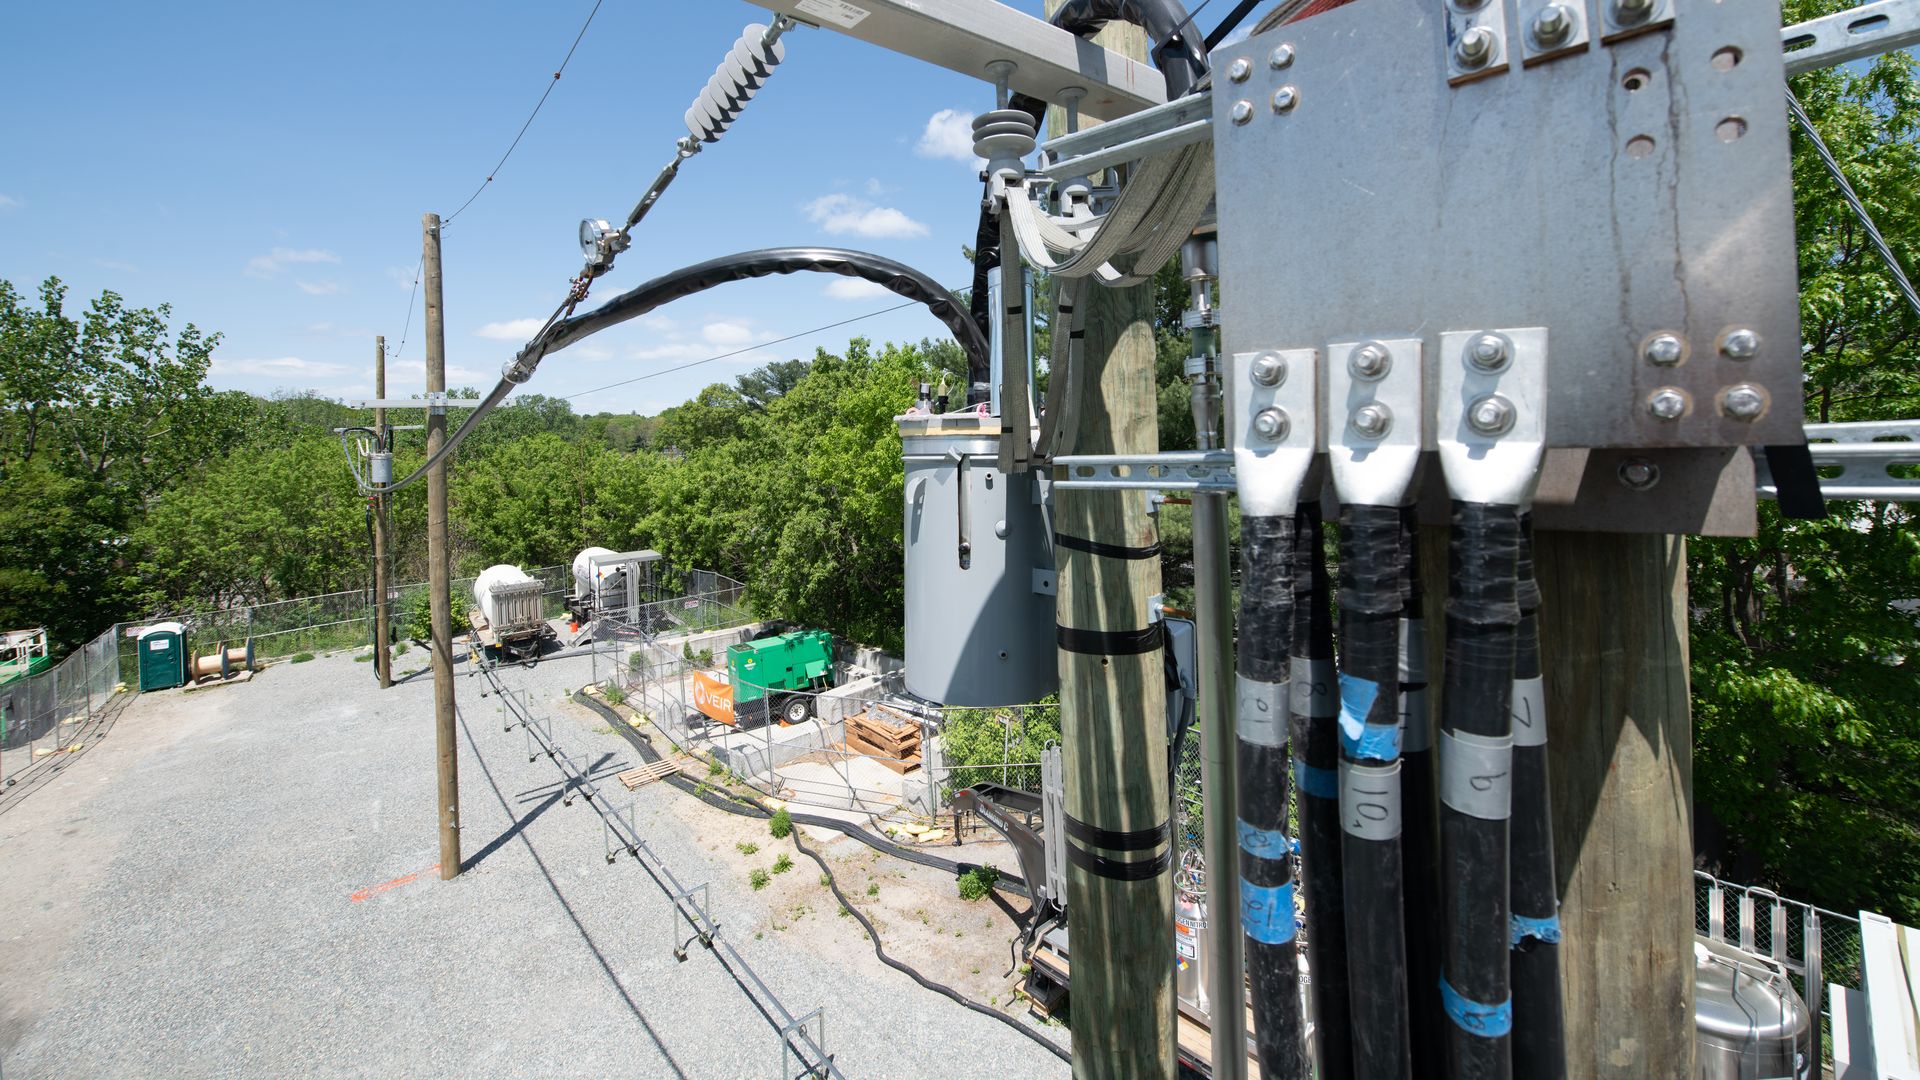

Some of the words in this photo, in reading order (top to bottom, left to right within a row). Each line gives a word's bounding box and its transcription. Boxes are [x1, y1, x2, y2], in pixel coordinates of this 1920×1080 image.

[705, 691, 732, 712] VEIR
[980, 803, 1003, 828] DIAMOND
[1003, 821, 1009, 832] C
